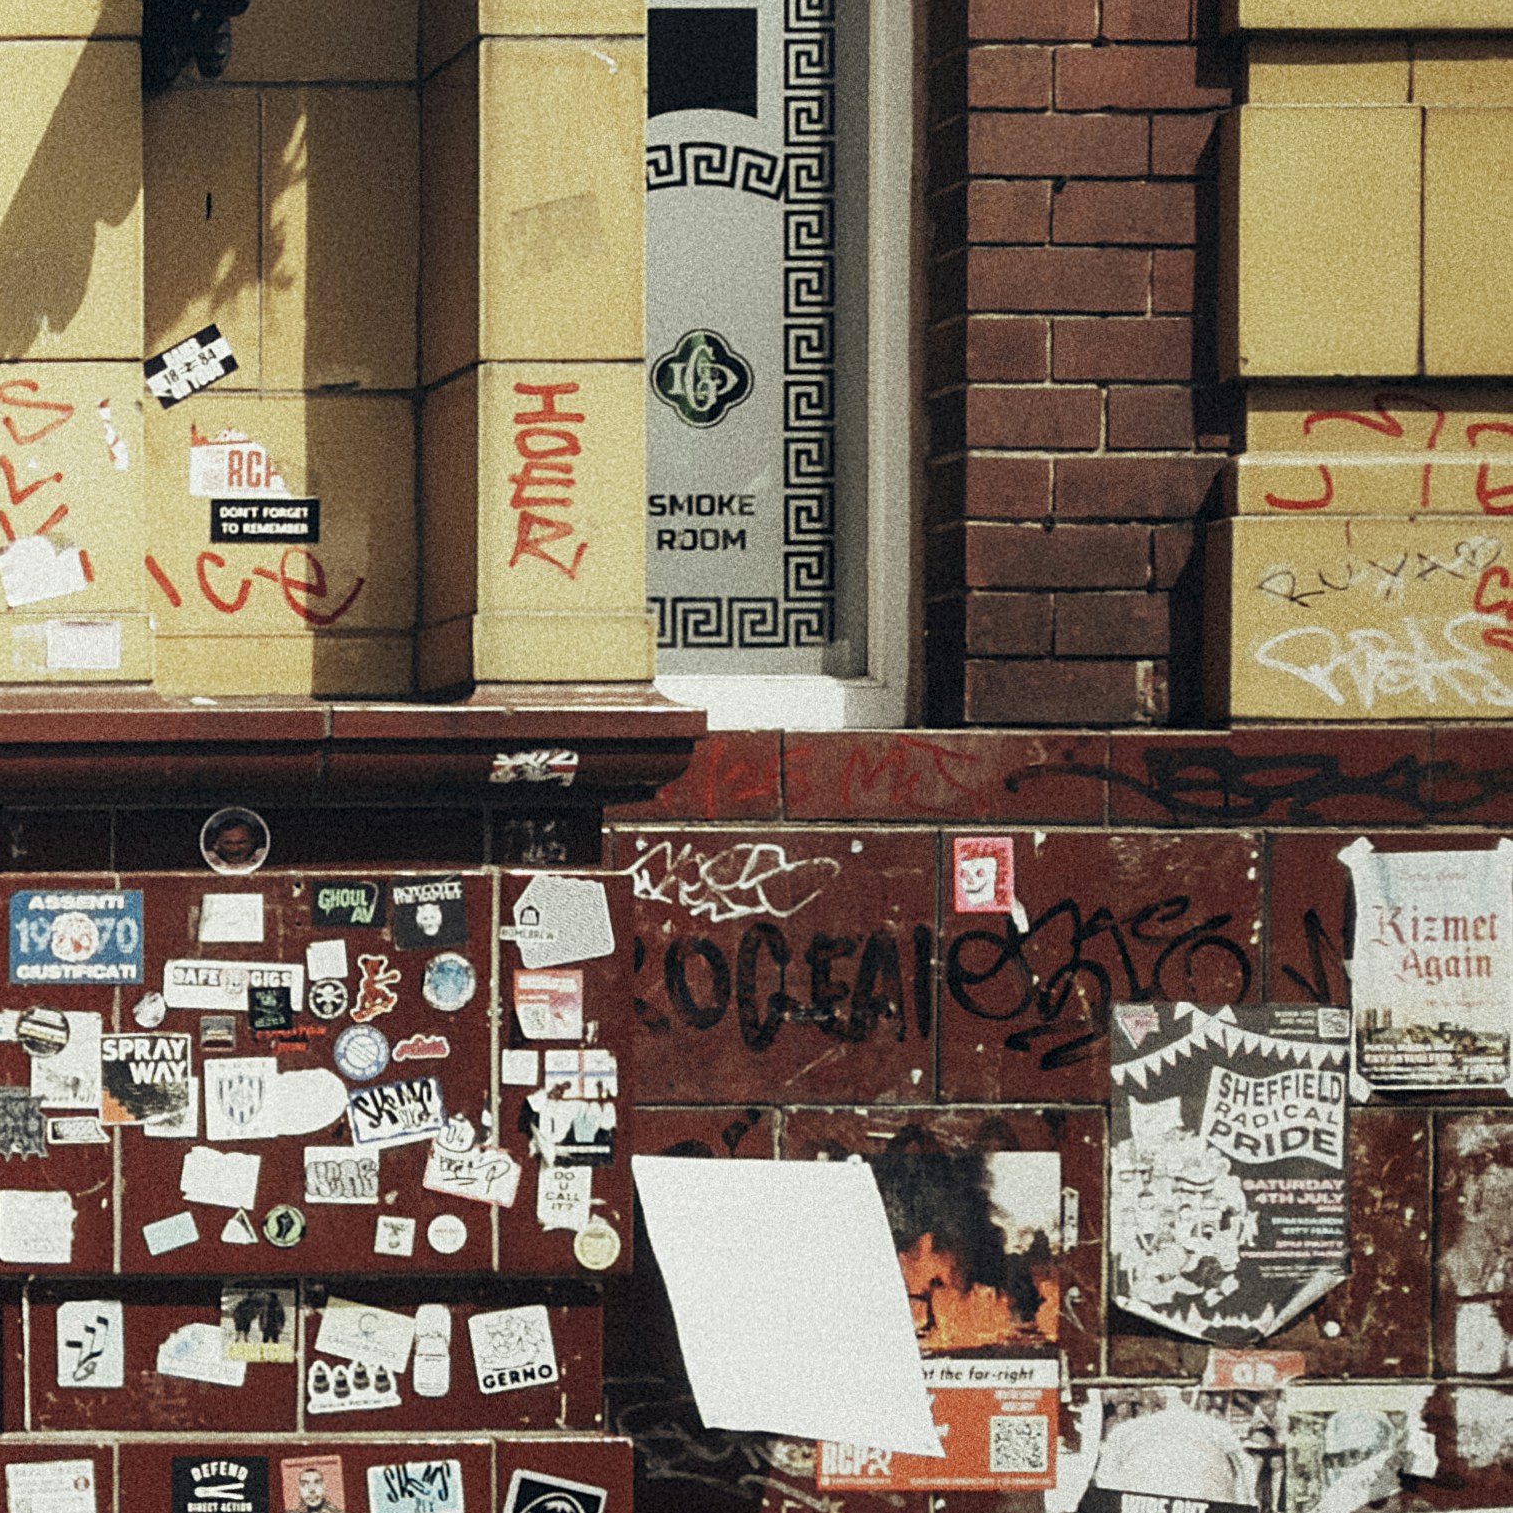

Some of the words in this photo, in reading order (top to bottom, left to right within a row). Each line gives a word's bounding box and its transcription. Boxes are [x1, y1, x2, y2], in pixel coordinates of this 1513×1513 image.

[219, 506, 259, 519] DON'T
[262, 506, 308, 519] FORGET
[648, 494, 756, 517] SMOKE
[221, 523, 239, 535] TO
[242, 523, 309, 535] REMEMBER
[27, 895, 125, 910] ASSENTI
[317, 888, 368, 915] GHOUL
[1371, 904, 1499, 947] Kizmet
[16, 963, 137, 980] GIUSTIFICATI
[1395, 947, 1493, 986] Again
[173, 967, 221, 987] SAFE
[249, 969, 293, 988] GIGS
[102, 1039, 185, 1062] SPRAY
[129, 1061, 187, 1084] WAY
[1219, 1071, 1343, 1107] SHEFFIELD
[1215, 1102, 1340, 1128] RADICAL
[1209, 1119, 1338, 1157] PRIDE
[554, 1171, 575, 1181] DO
[559, 1182, 569, 1191] U
[1242, 1178, 1345, 1191] SATURDAY
[1255, 1192, 1294, 1205] 4TH
[1296, 1192, 1345, 1205] JULY
[941, 1369, 962, 1382] the
[969, 1368, 1034, 1384] far-right
[190, 1461, 249, 1482] DEFEND
[187, 1502, 219, 1513] DIRECT
[221, 1501, 253, 1513] ACTION
